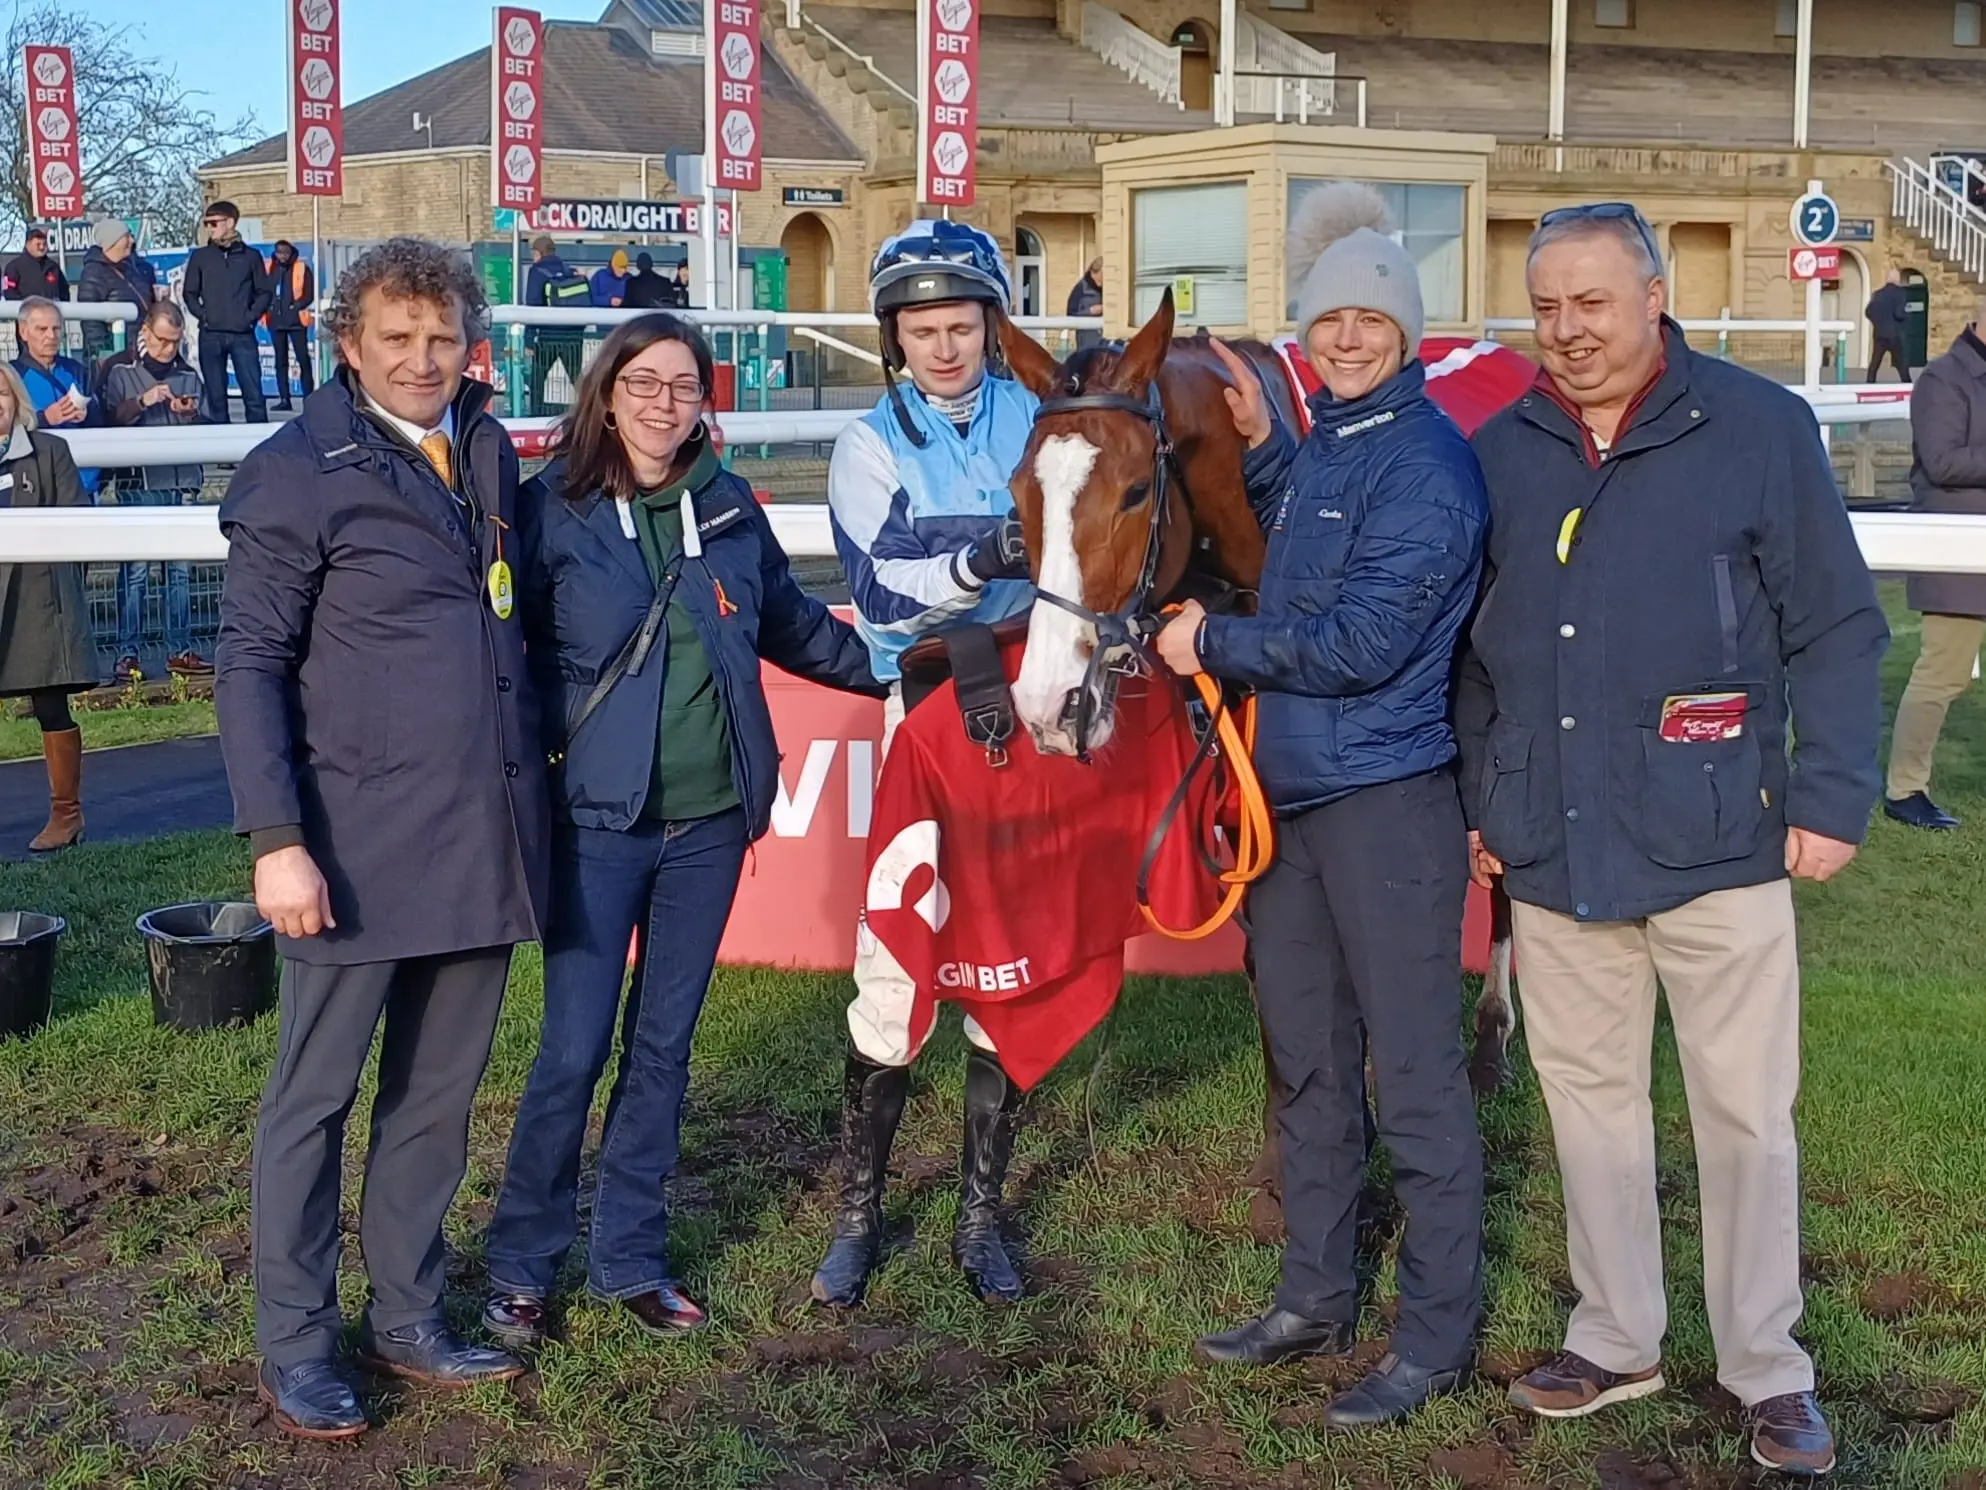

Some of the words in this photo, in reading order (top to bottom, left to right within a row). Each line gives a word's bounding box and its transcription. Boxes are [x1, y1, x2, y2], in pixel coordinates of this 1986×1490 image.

[721, 3, 753, 27] BET
[300, 32, 333, 52] BET
[935, 32, 970, 54] BET
[504, 57, 535, 76] BET
[36, 87, 67, 103] BET
[721, 81, 754, 104] BET
[302, 101, 334, 121] BET
[934, 105, 969, 126] BET
[504, 121, 535, 139] BET
[40, 142, 71, 157] BET
[303, 168, 335, 188] BET
[722, 158, 755, 180] BET
[504, 184, 535, 203] BET
[932, 177, 967, 197] BET
[44, 196, 76, 211] BET
[576, 203, 682, 231] DRAUGHT
[685, 206, 731, 232] BR
[978, 957, 1032, 992] BET
